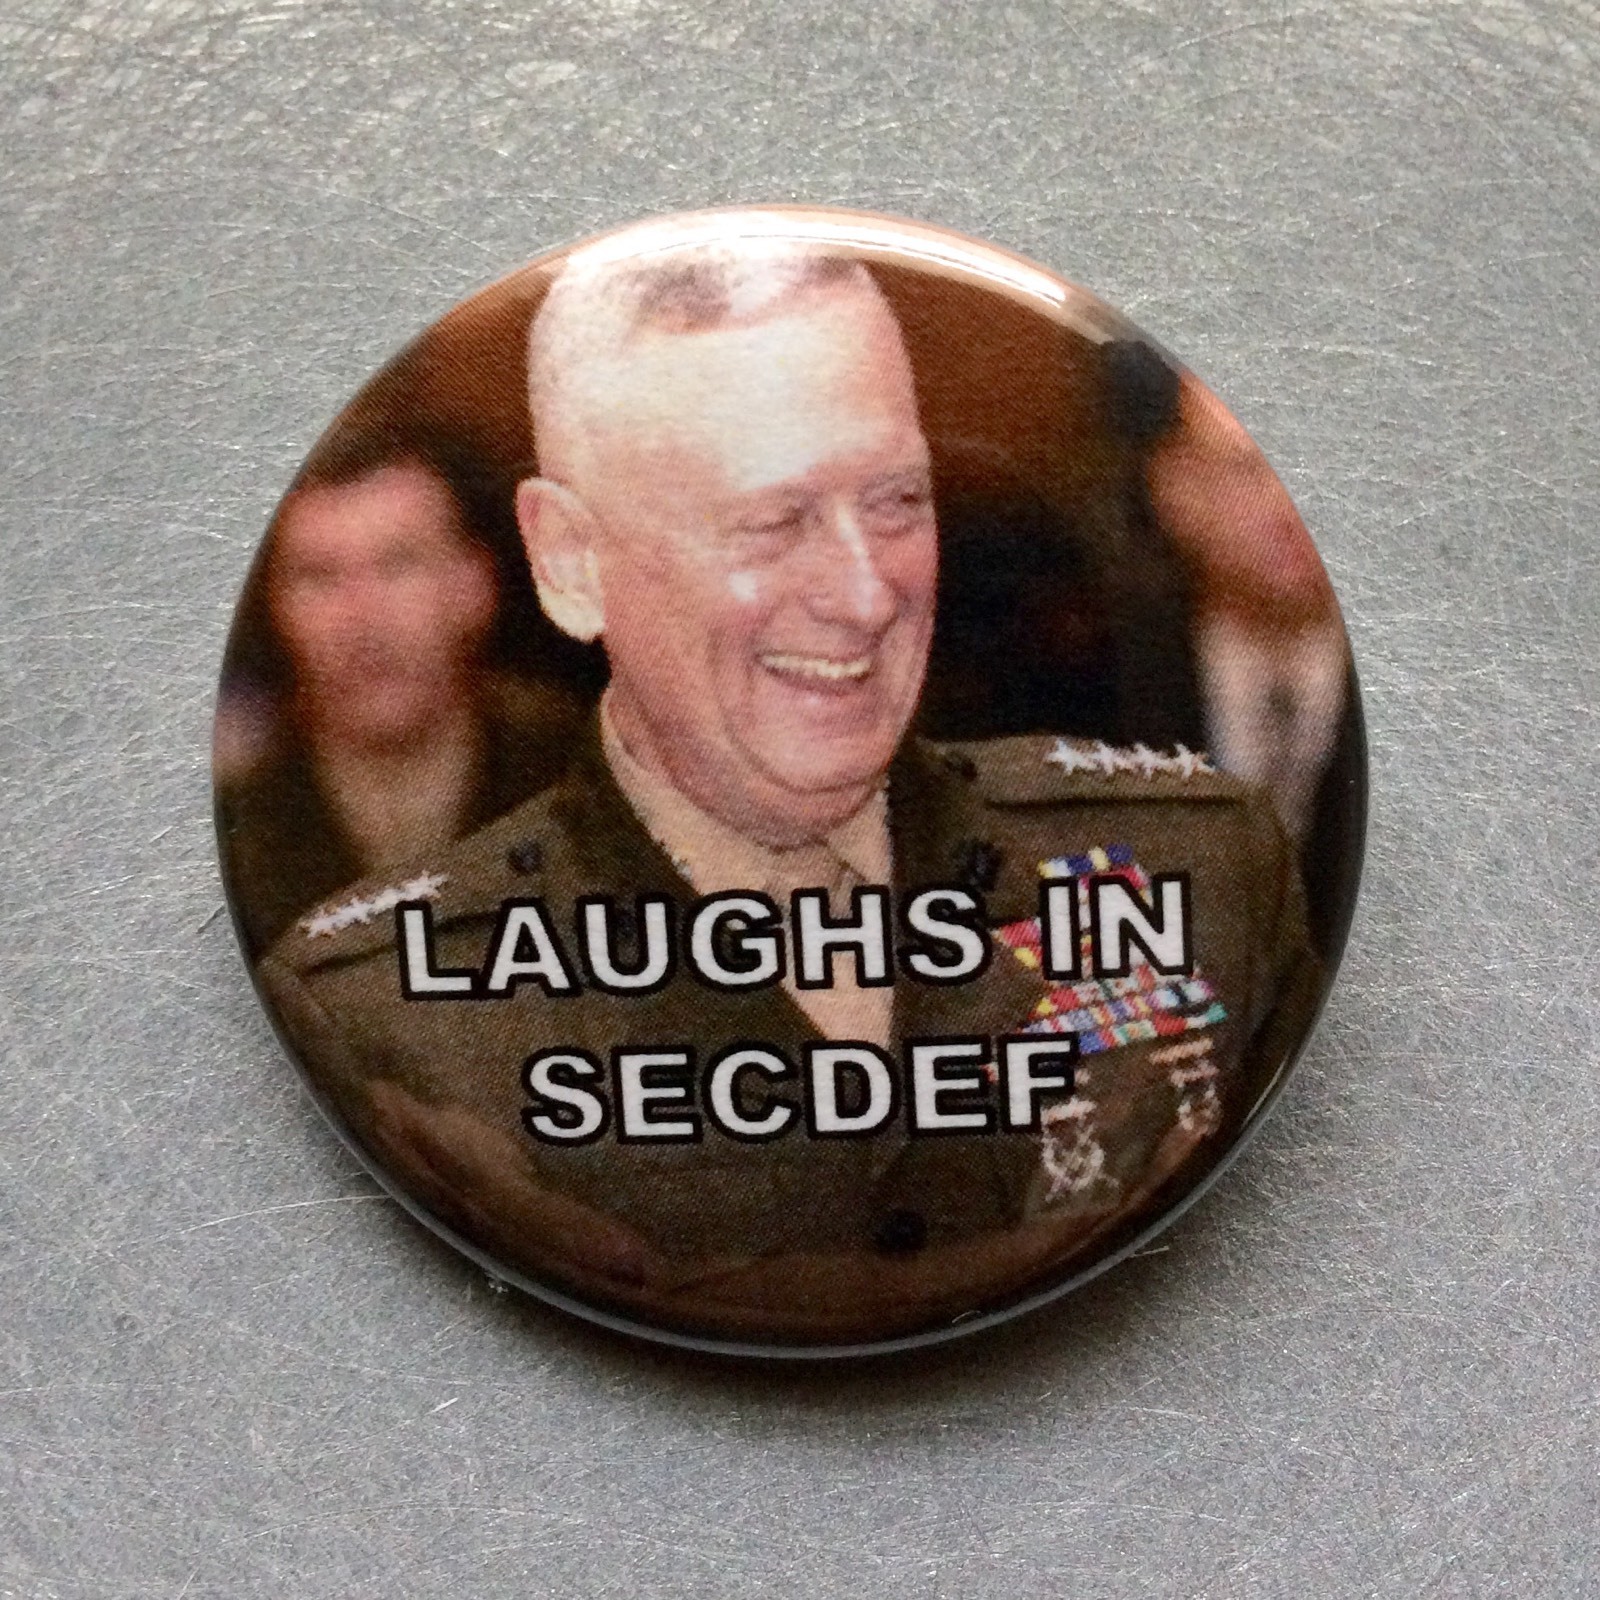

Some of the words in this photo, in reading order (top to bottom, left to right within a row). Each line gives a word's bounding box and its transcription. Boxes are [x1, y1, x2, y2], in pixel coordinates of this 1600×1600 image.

[399, 886, 988, 996] LAUGHS
[1043, 876, 1191, 980] IN
[523, 1037, 1075, 1142] SECDEF
